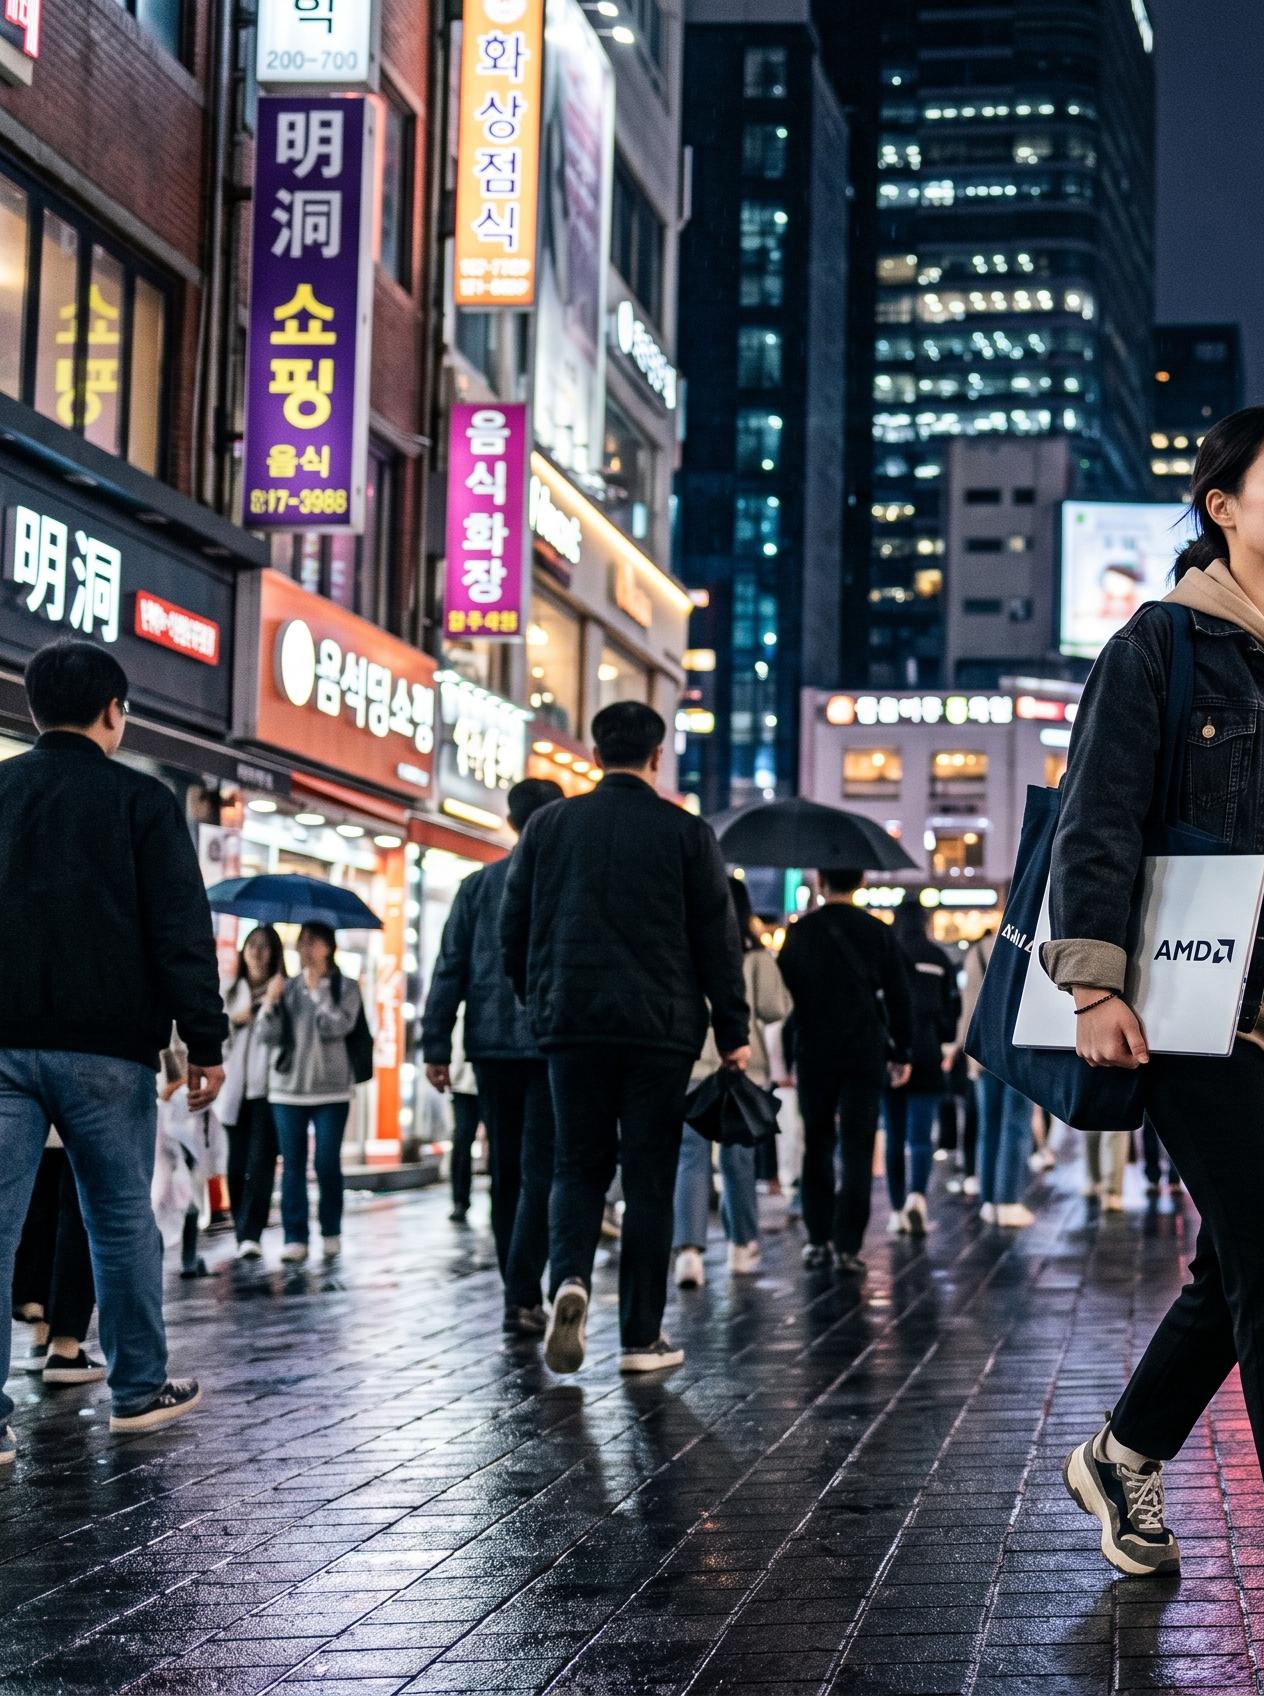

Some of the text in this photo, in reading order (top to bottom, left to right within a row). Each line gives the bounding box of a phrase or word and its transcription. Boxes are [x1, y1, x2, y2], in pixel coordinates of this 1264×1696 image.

[265, 50, 359, 71] 200-700
[270, 109, 345, 259] 明洞
[476, 33, 527, 249] 화상점식
[269, 283, 337, 430] 쇼핑
[266, 443, 331, 479] 음식
[461, 409, 512, 604] 음식화장
[14, 505, 122, 643] 明洞
[1153, 939, 1213, 961] AMD
